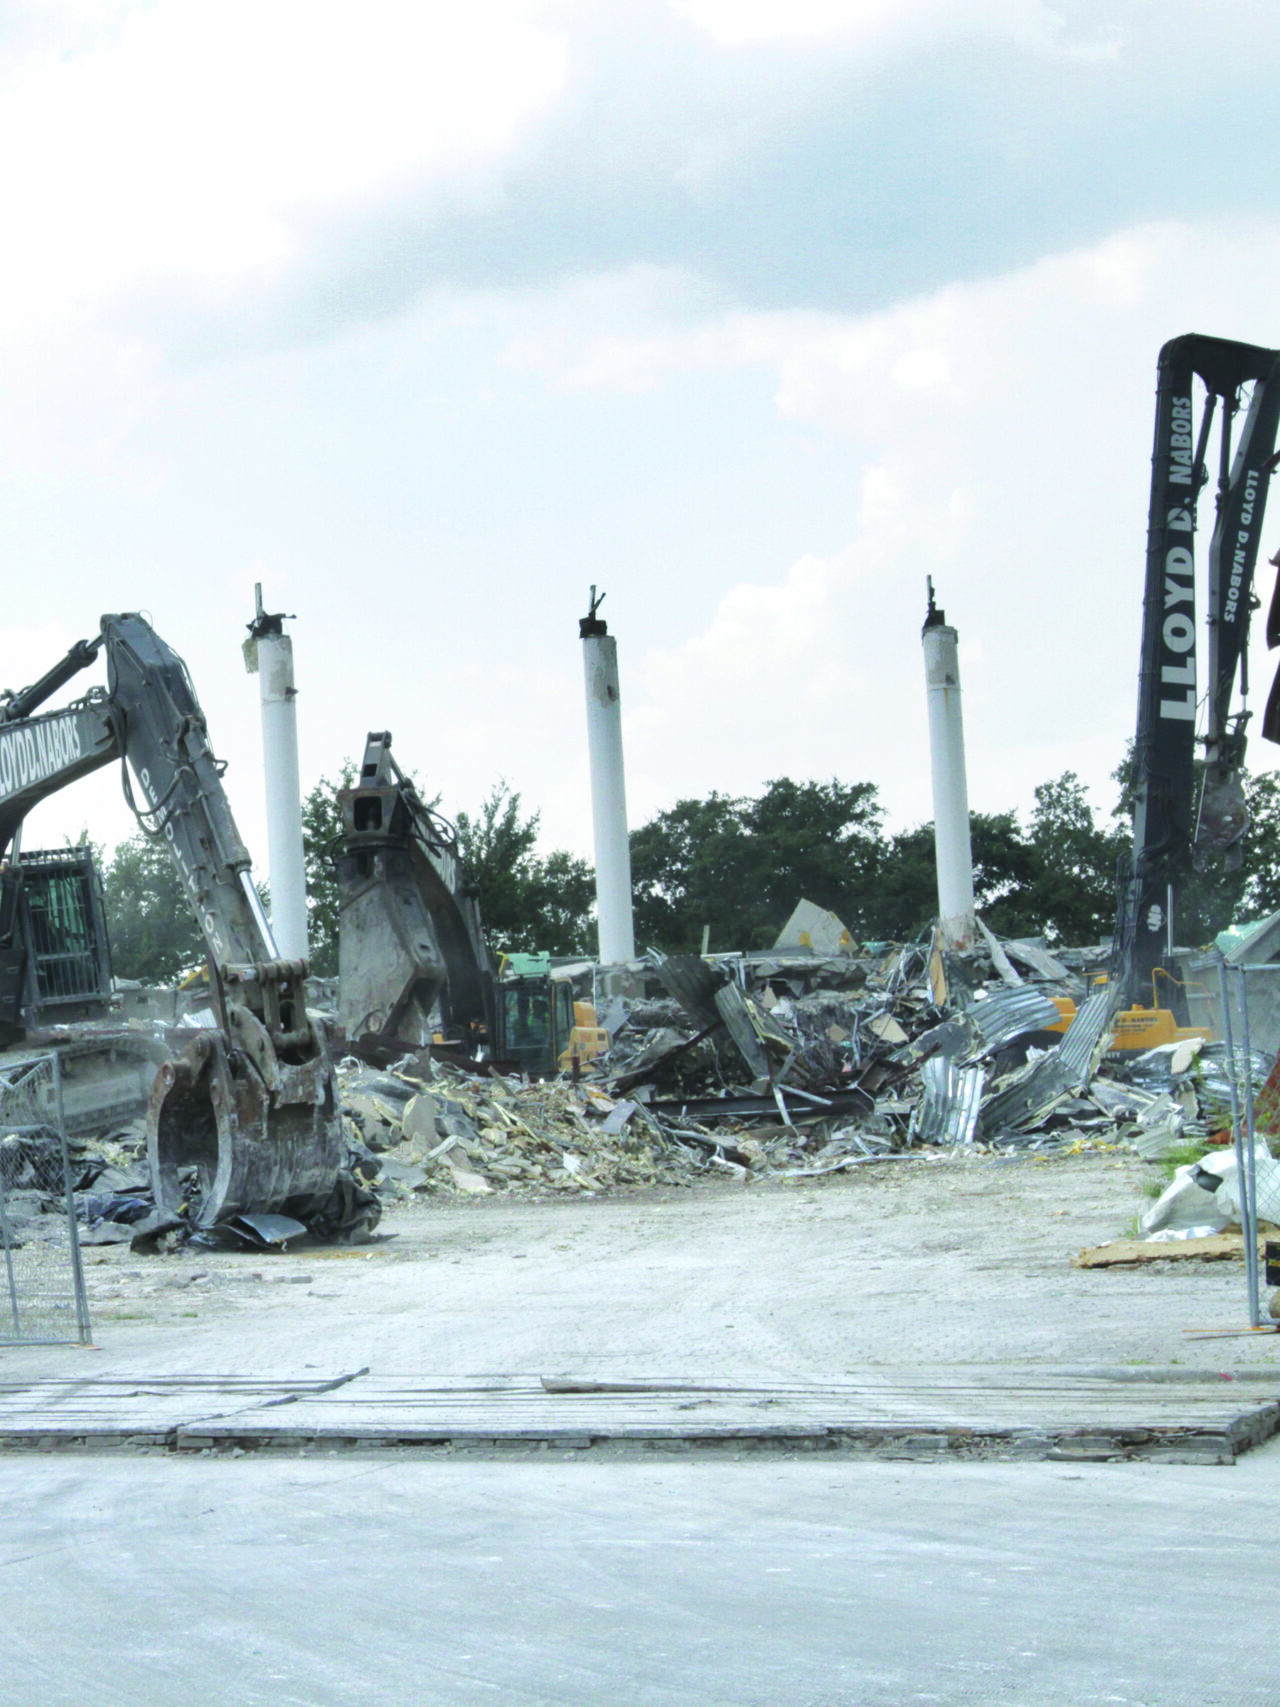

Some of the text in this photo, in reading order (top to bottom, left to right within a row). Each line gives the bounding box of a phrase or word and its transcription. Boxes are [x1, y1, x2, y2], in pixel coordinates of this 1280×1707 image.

[1168, 397, 1192, 485] NABORS
[1240, 470, 1260, 525] LLOYD
[1160, 546, 1195, 721] LLOYD
